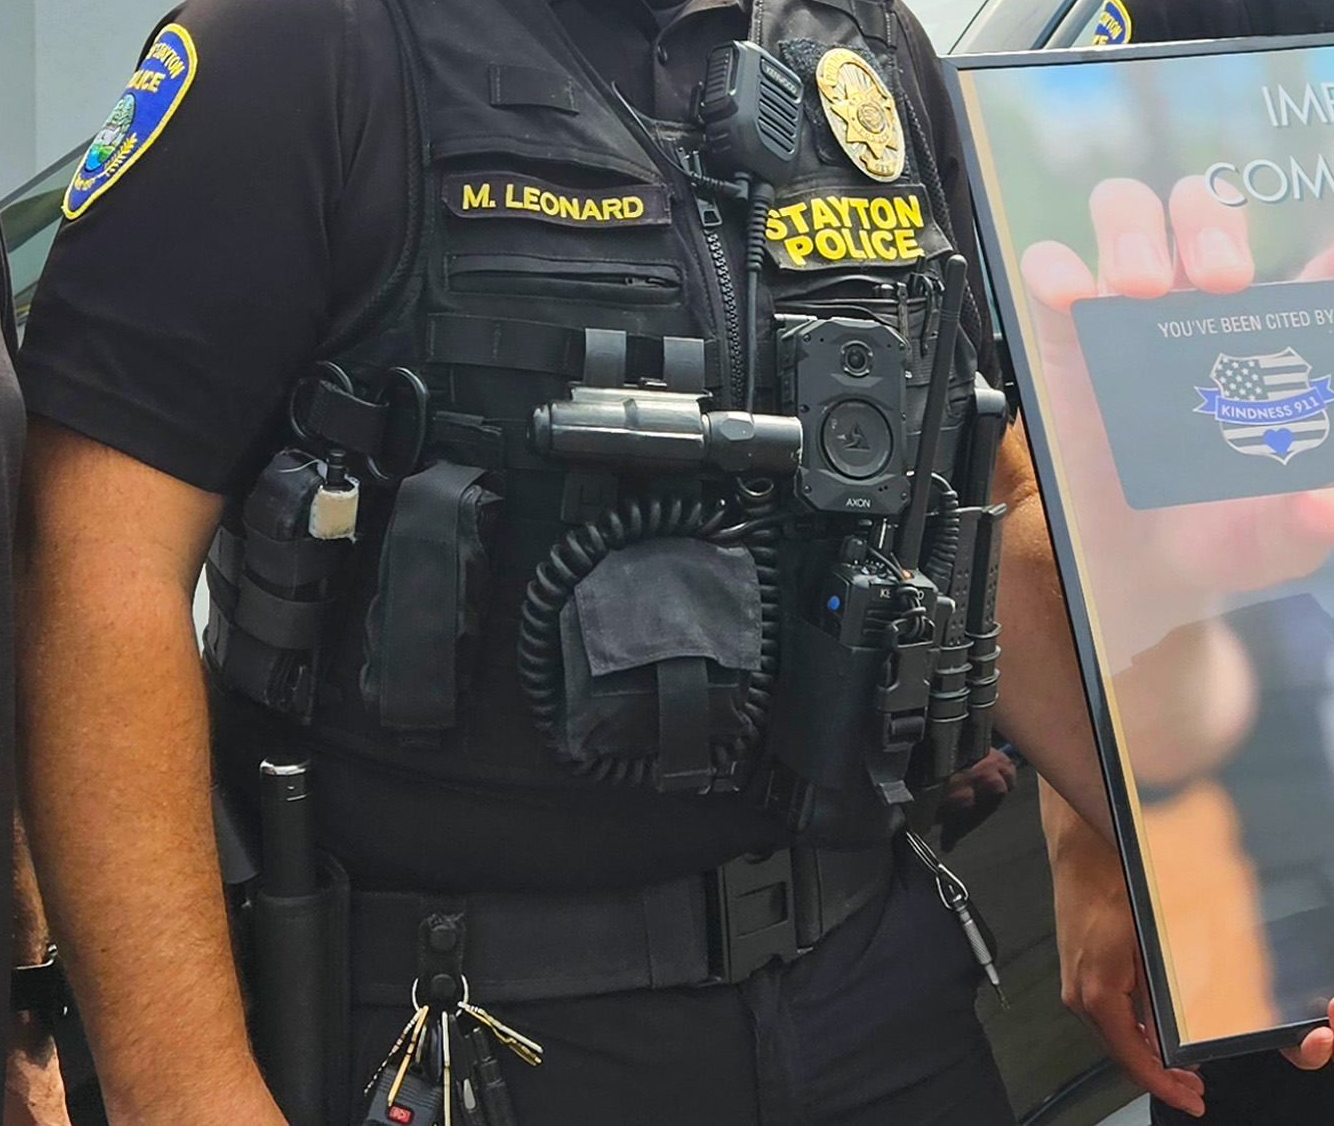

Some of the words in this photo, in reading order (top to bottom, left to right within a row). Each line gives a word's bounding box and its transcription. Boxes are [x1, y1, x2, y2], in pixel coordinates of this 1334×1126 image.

[462, 184, 497, 211] M.
[505, 184, 645, 221] LEONARD
[766, 195, 925, 241] STAYTON
[785, 226, 925, 266] POLICE
[1157, 318, 1218, 338] YOU'VE
[1220, 315, 1262, 333] BEEN
[1265, 310, 1311, 330] CITED
[1314, 308, 1334, 325] BY
[1221, 404, 1294, 420] KINDNESS
[1294, 396, 1320, 414] 911
[846, 498, 871, 508] AXON
